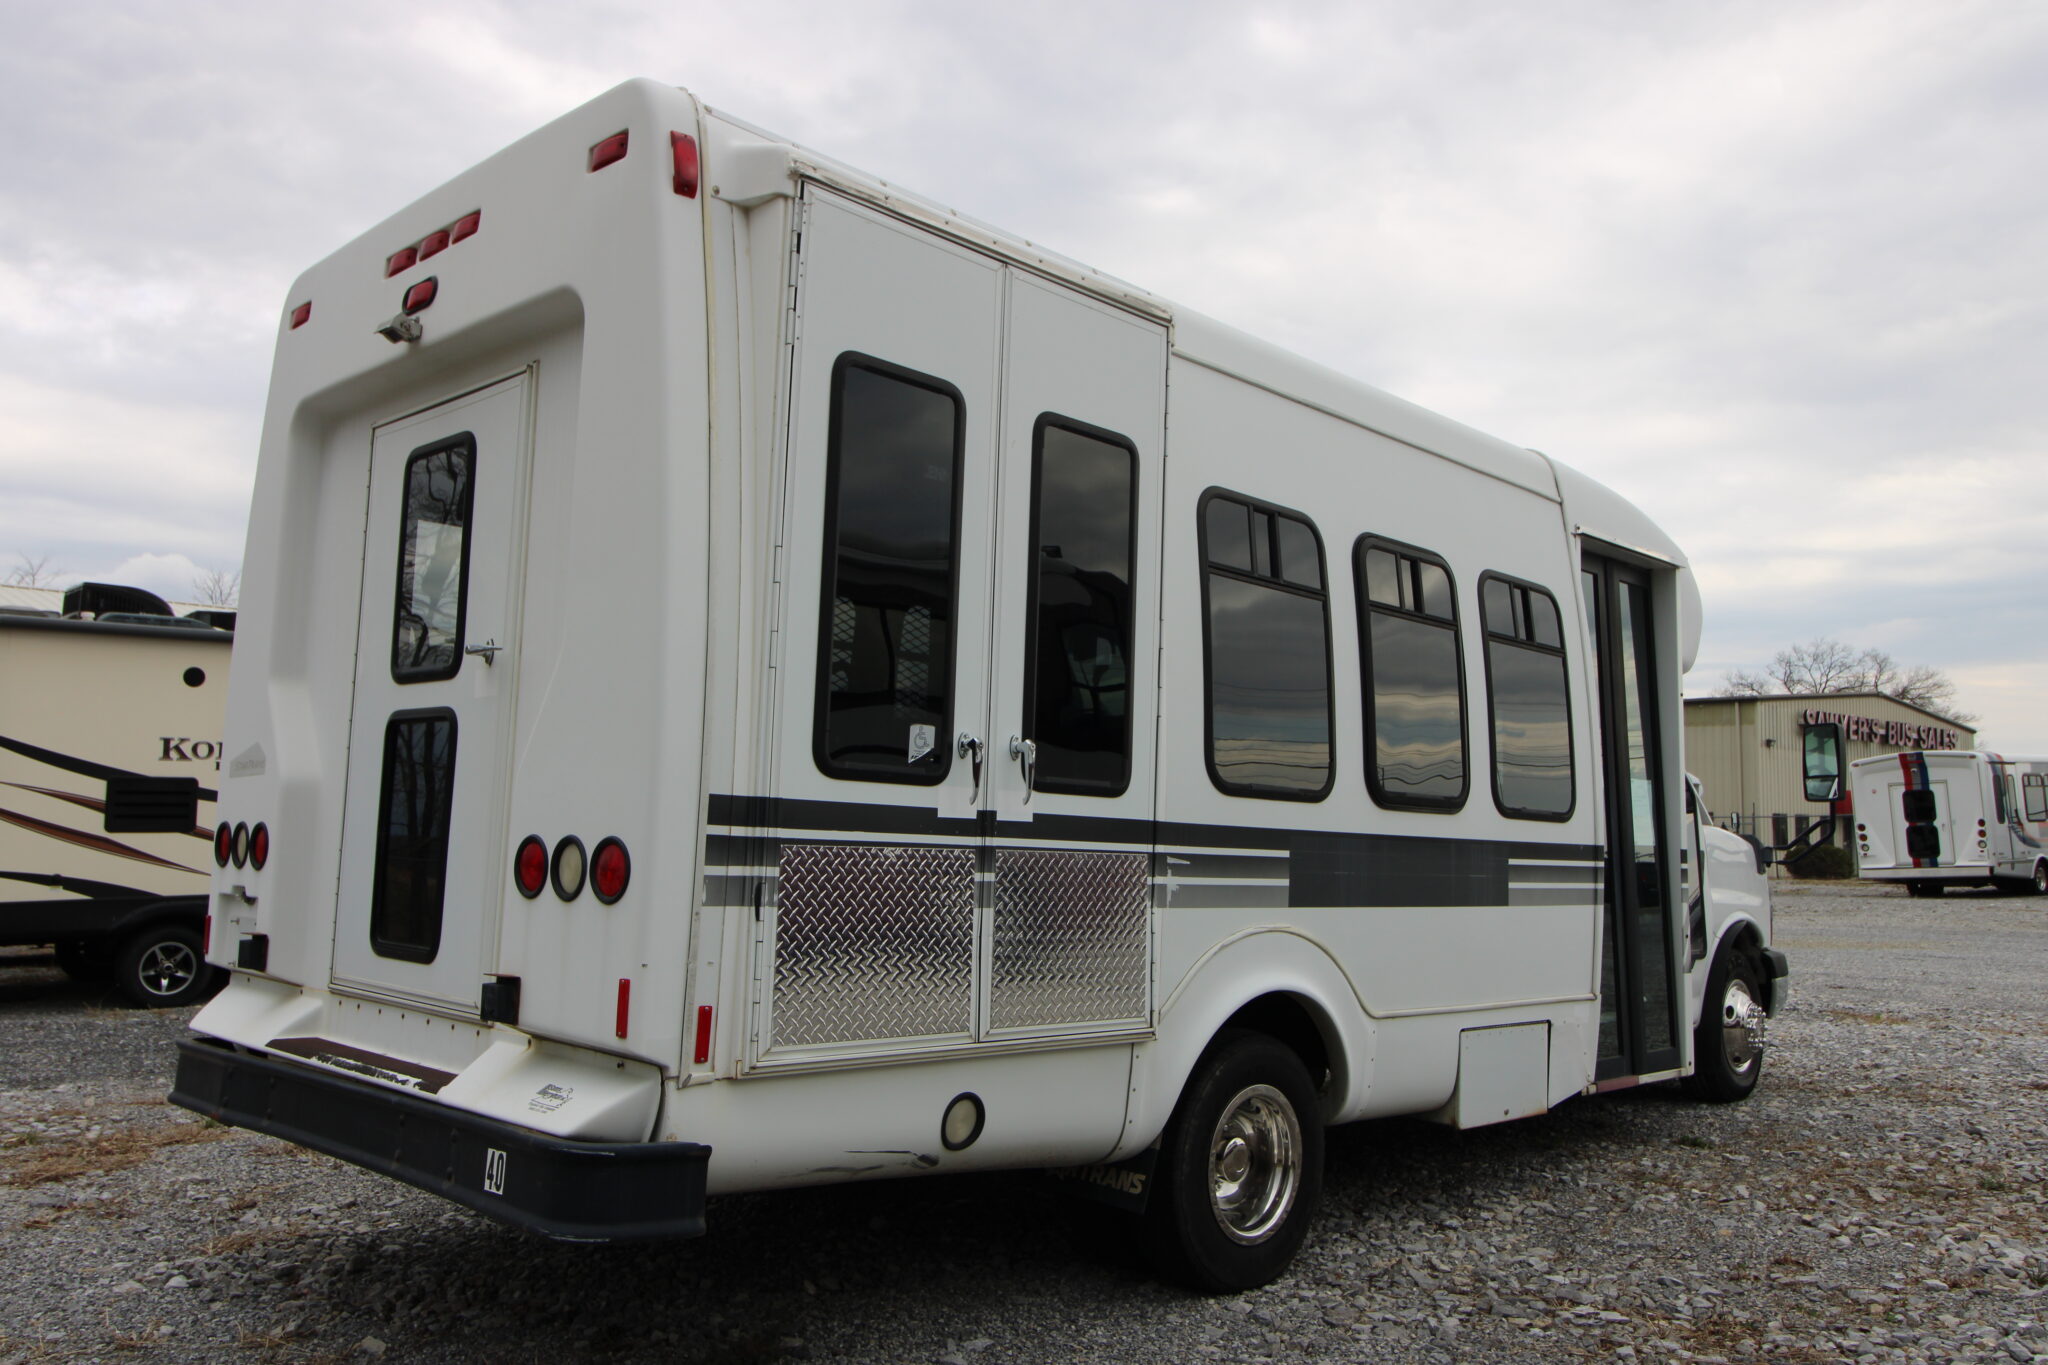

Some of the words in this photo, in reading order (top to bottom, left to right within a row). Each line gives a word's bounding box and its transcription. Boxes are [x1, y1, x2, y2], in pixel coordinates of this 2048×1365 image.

[1887, 721, 1914, 747] BUS
[1919, 725, 1958, 750] SALES
[486, 1151, 504, 1192] 40
